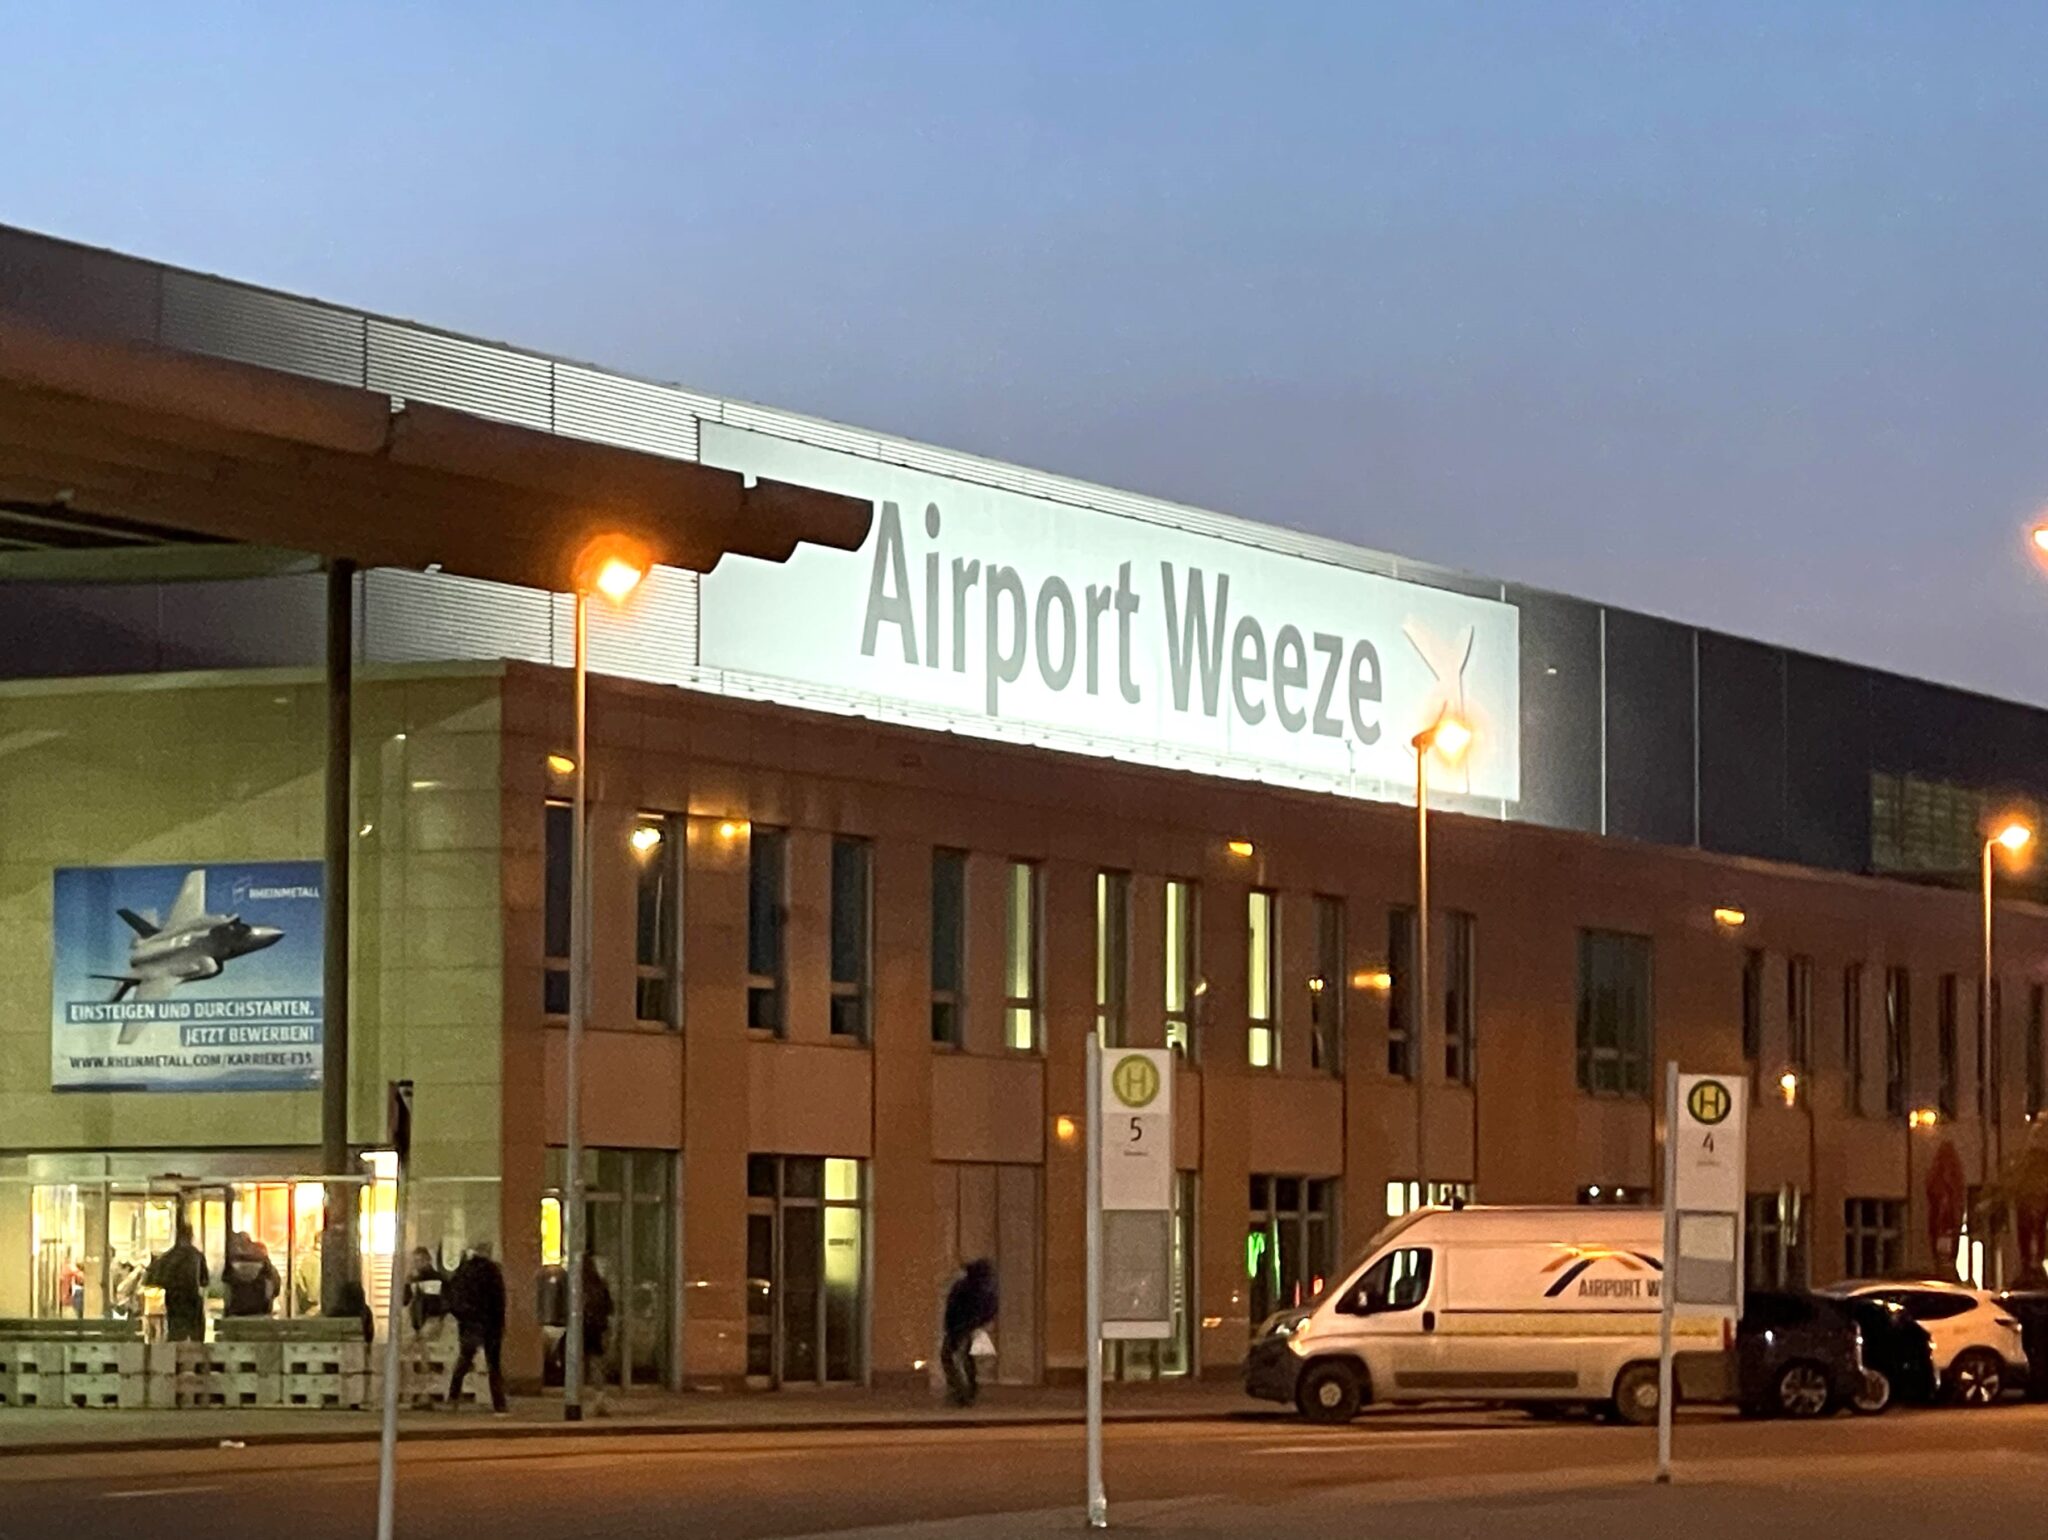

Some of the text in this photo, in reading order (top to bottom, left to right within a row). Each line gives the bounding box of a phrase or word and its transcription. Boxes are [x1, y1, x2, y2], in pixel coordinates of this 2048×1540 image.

[860, 500, 1382, 745] Airport Weeze
[70, 1000, 314, 1020] EINSTEIGEN UND DURCHSTARTEN.
[185, 1027, 224, 1045] JETZT
[1126, 1066, 1147, 1098] H
[1699, 1087, 1719, 1117] H
[1130, 1116, 1142, 1142] 5
[1702, 1131, 1714, 1153] 4
[1578, 1278, 1641, 1297] AIRPORT
